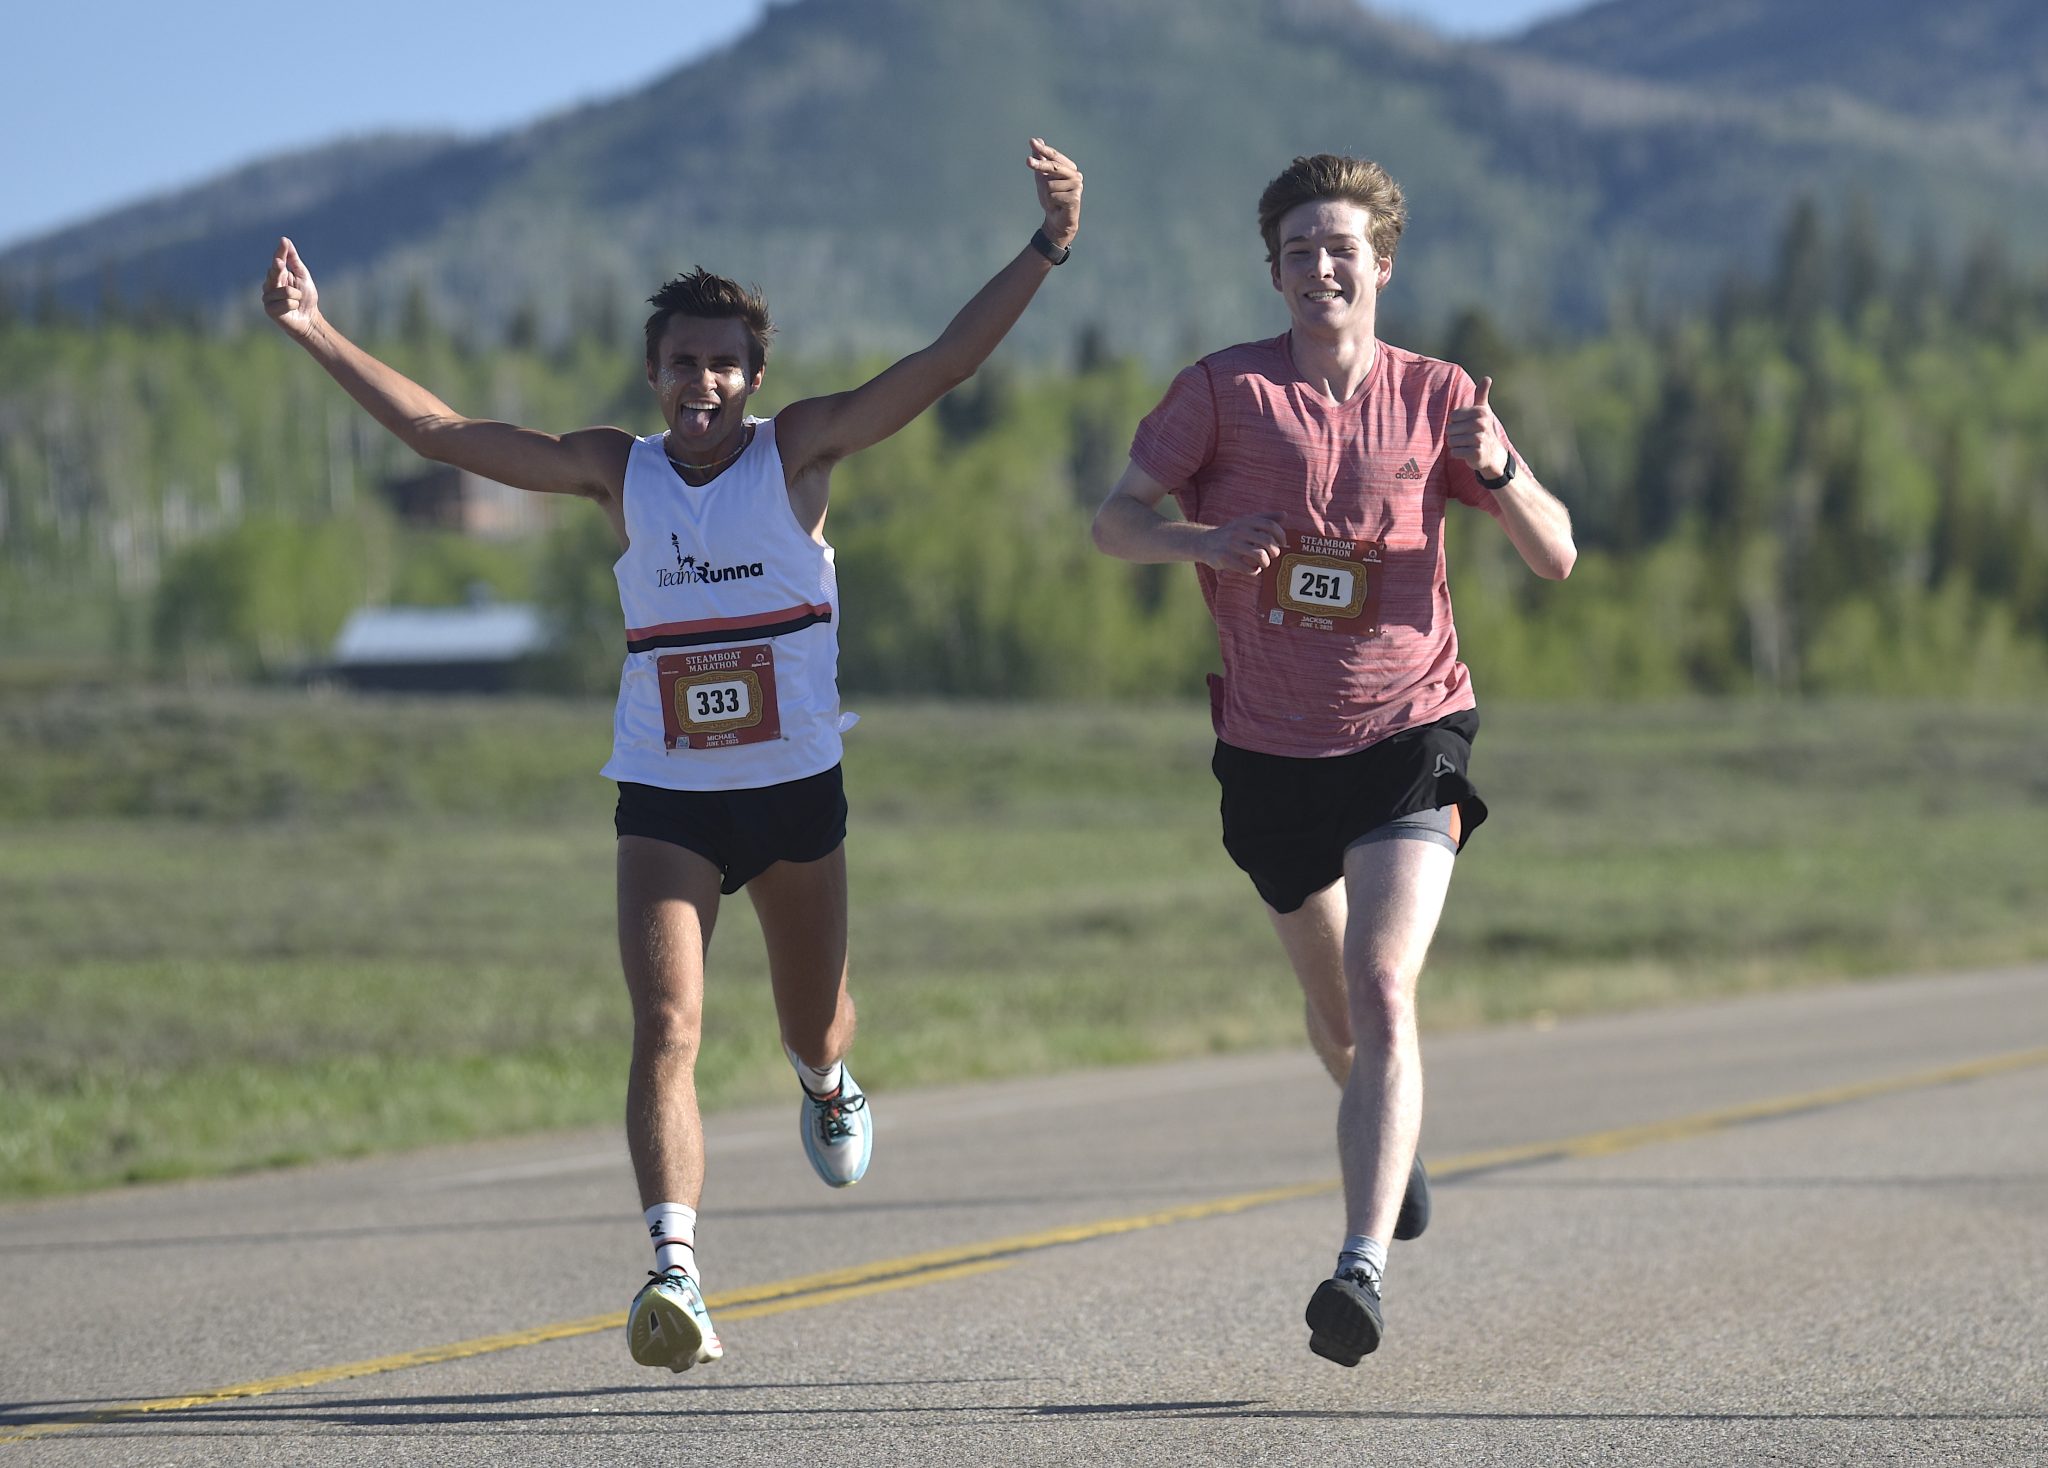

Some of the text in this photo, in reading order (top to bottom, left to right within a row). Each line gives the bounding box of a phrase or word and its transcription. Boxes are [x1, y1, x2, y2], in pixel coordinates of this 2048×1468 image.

[1300, 535, 1356, 551] STEAMBOAT
[1301, 544, 1351, 558] MARATHON
[656, 561, 764, 588] Team Runna
[1299, 572, 1341, 601] 251
[685, 651, 742, 666] STEAMBOAT
[689, 660, 738, 673] MARATHON
[696, 688, 740, 716] 333
[706, 733, 737, 742] MICHAEL
